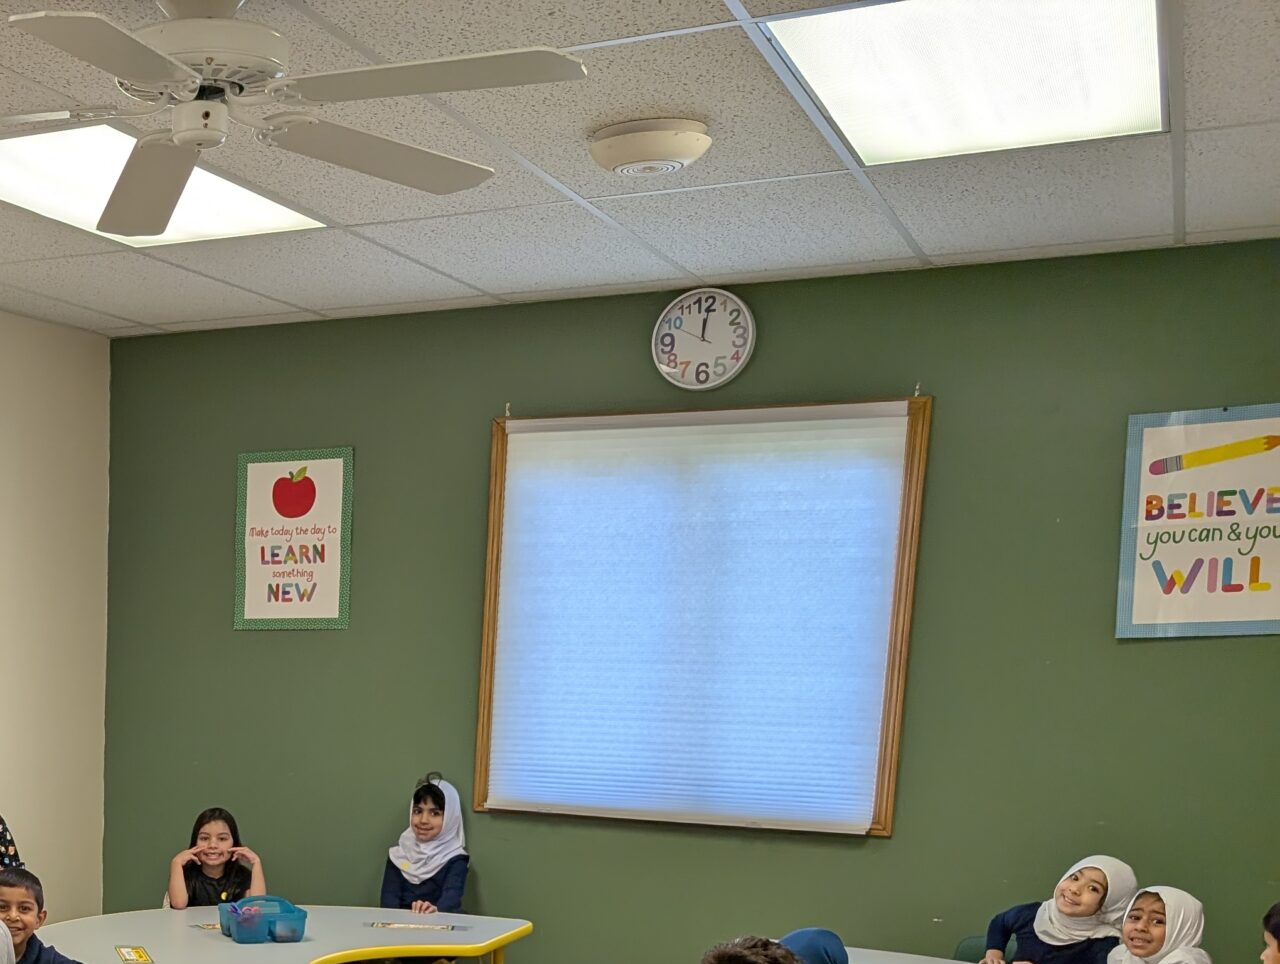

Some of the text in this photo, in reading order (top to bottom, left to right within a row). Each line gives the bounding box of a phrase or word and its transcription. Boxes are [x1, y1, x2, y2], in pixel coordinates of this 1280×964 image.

[677, 304, 692, 316] 11
[692, 295, 717, 314] 12
[720, 299, 728, 312] 1
[665, 316, 683, 331] 10
[729, 308, 741, 327] 2
[660, 332, 676, 355] 9
[732, 325, 748, 349] 3
[667, 353, 678, 369] 8
[730, 350, 741, 363] 4
[679, 361, 691, 379] 7
[695, 362, 710, 385] 6
[713, 356, 727, 377] 5
[1145, 486, 1280, 521] BELIEVE
[249, 523, 337, 542] Make today the day to
[1139, 529, 1185, 561] you
[1188, 527, 1222, 543] can
[1227, 522, 1242, 541] &
[260, 543, 325, 566] LEARN
[272, 569, 313, 583] something
[1151, 555, 1272, 595] WILL
[267, 582, 317, 603] NEW
